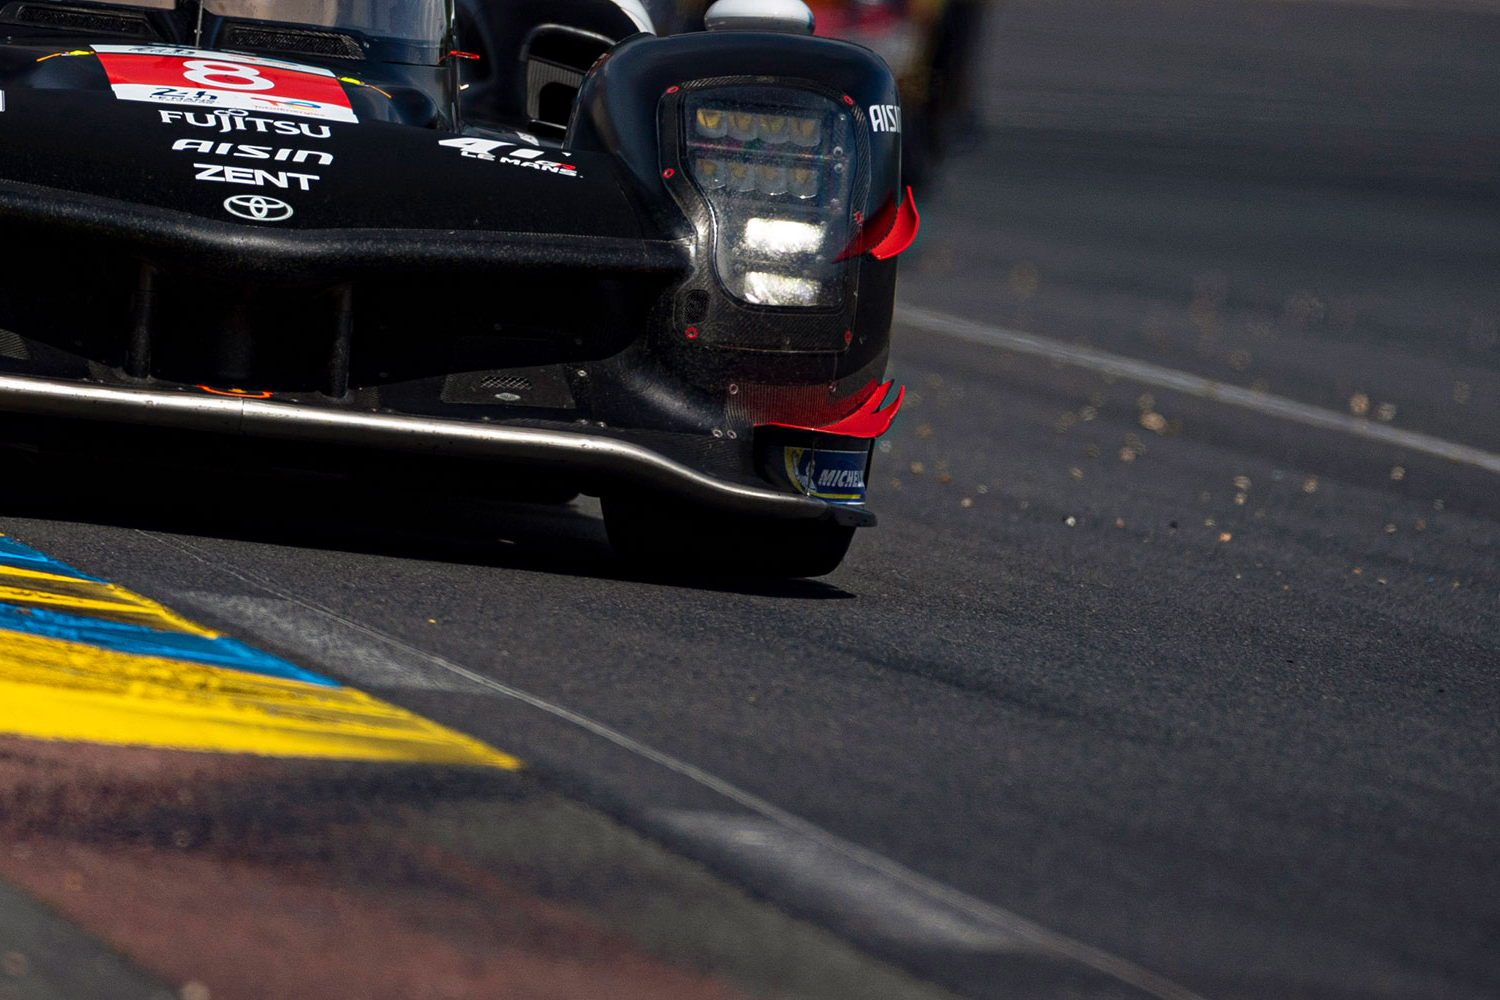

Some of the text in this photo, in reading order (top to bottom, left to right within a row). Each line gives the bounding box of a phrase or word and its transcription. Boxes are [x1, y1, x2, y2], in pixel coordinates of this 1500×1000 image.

[182, 60, 276, 91] 8
[157, 109, 332, 139] FUJITSU
[171, 138, 335, 166] AISIN
[193, 162, 321, 191] ZENT
